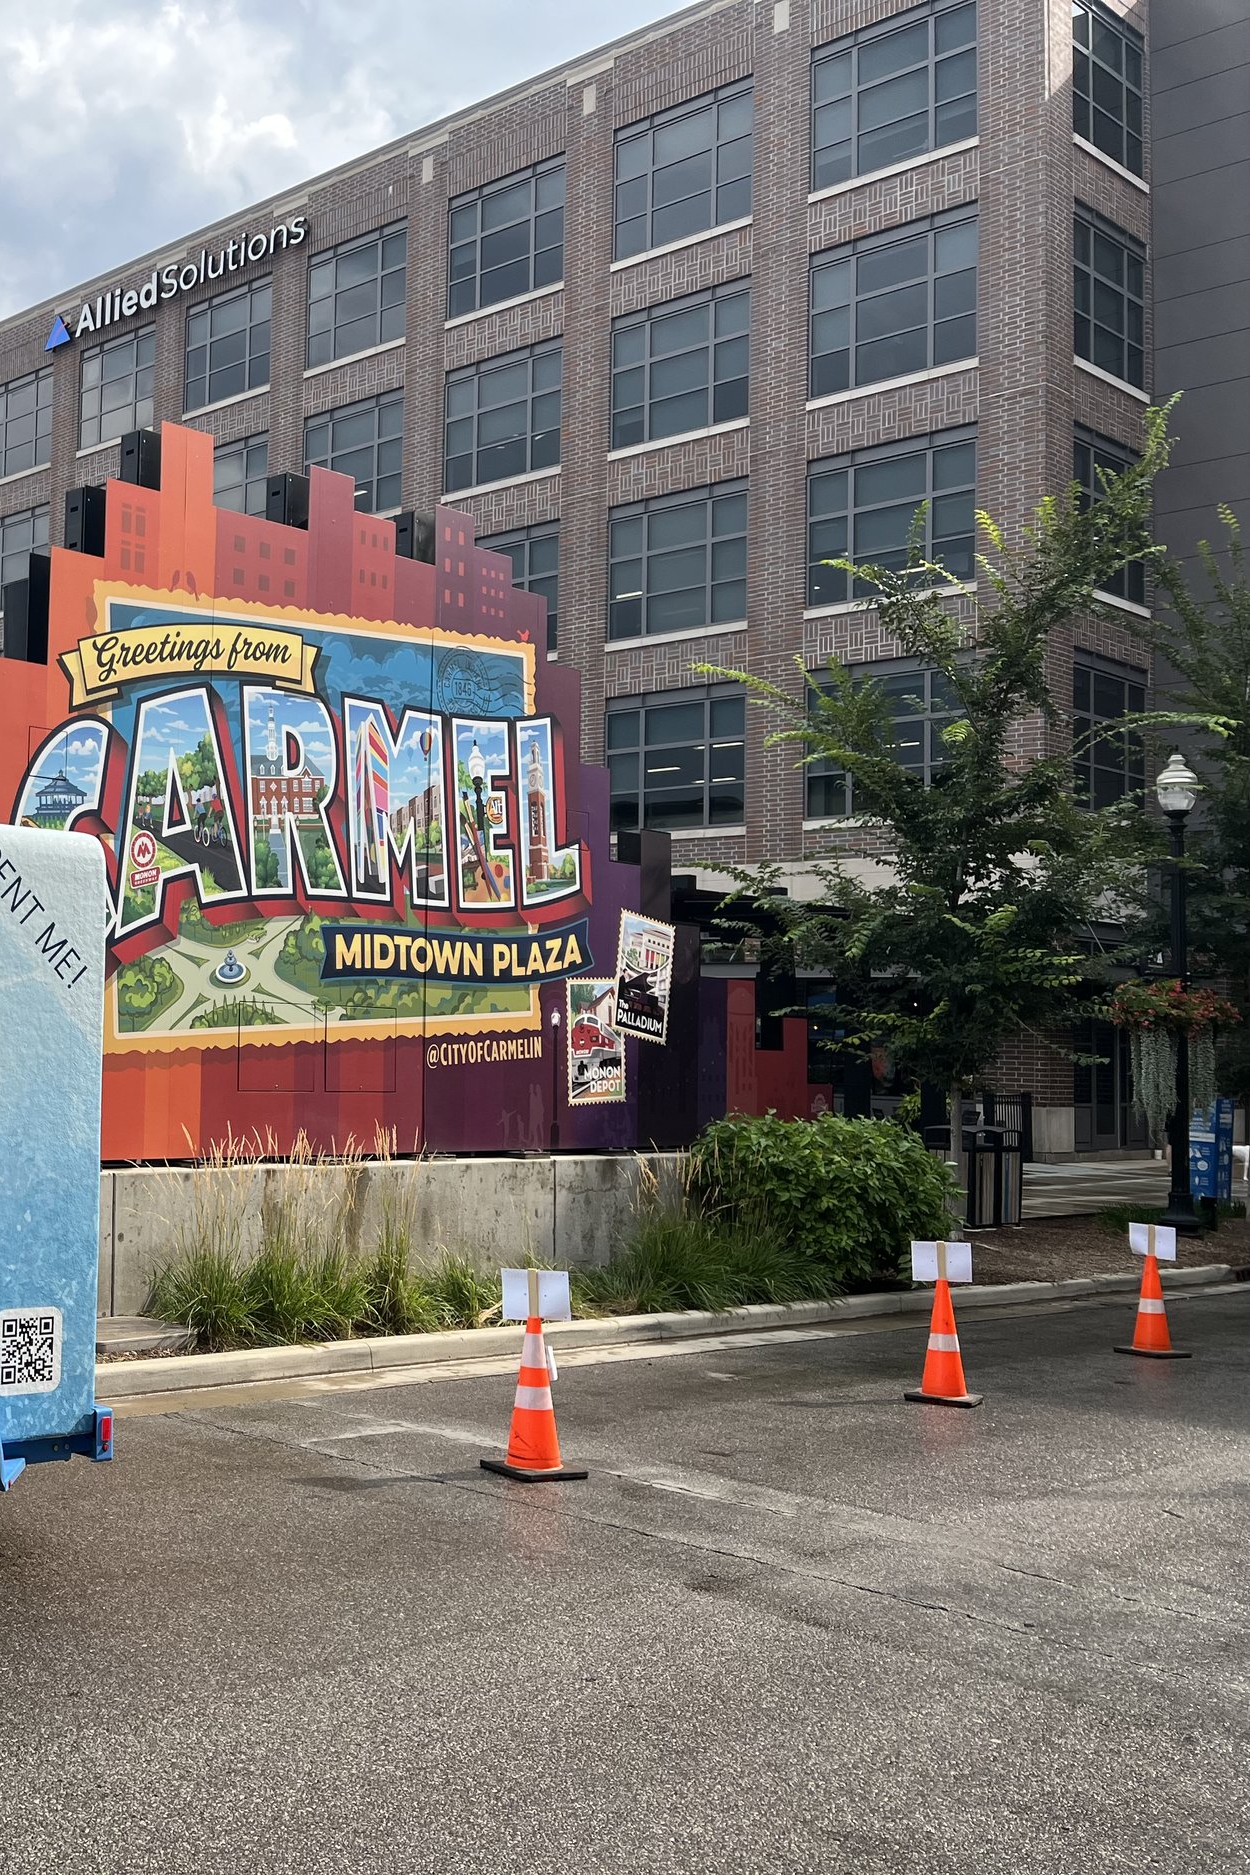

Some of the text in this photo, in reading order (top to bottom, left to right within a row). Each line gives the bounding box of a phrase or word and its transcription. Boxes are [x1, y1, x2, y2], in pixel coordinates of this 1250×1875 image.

[93, 632, 292, 681] Greetings from
[35, 922, 87, 989] ME!
[335, 932, 582, 977] MIDTOWN PLAZA
[618, 998, 629, 1010] The
[617, 1009, 662, 1034] PALLADIUM
[426, 1036, 543, 1069] @CITYOFCARMELIN
[584, 1065, 621, 1080] MONON
[590, 1079, 621, 1094] DEPOT
